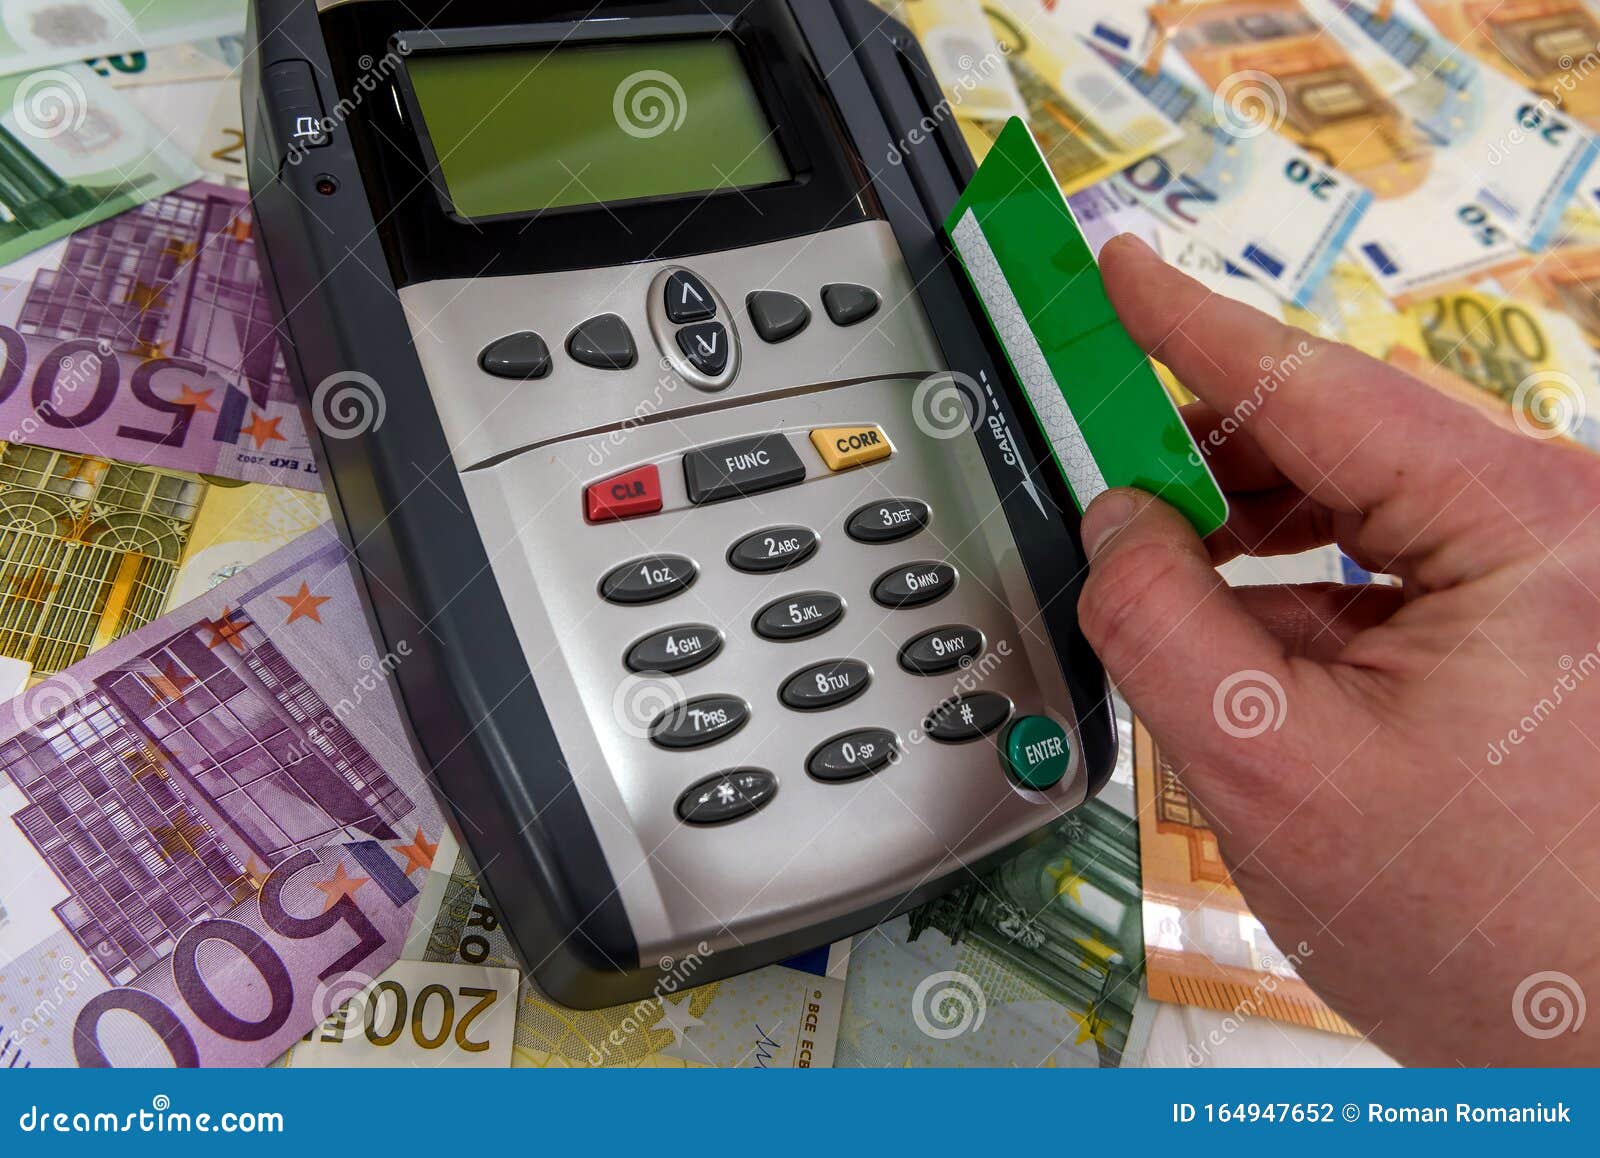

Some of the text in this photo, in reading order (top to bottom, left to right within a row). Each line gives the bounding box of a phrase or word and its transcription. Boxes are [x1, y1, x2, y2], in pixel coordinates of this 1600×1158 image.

[1284, 157, 1338, 200] 20
[1457, 204, 1506, 247] 50
[837, 430, 880, 453] CORR
[988, 415, 1016, 466] CARD
[270, 458, 299, 470] EKP
[725, 450, 770, 473] FUNC
[611, 480, 646, 501] CLR
[960, 703, 974, 725] #
[1025, 735, 1064, 765] ENTER
[73, 847, 387, 1068] 500
[364, 980, 498, 1053] 200
[805, 1003, 820, 1033] BCE
